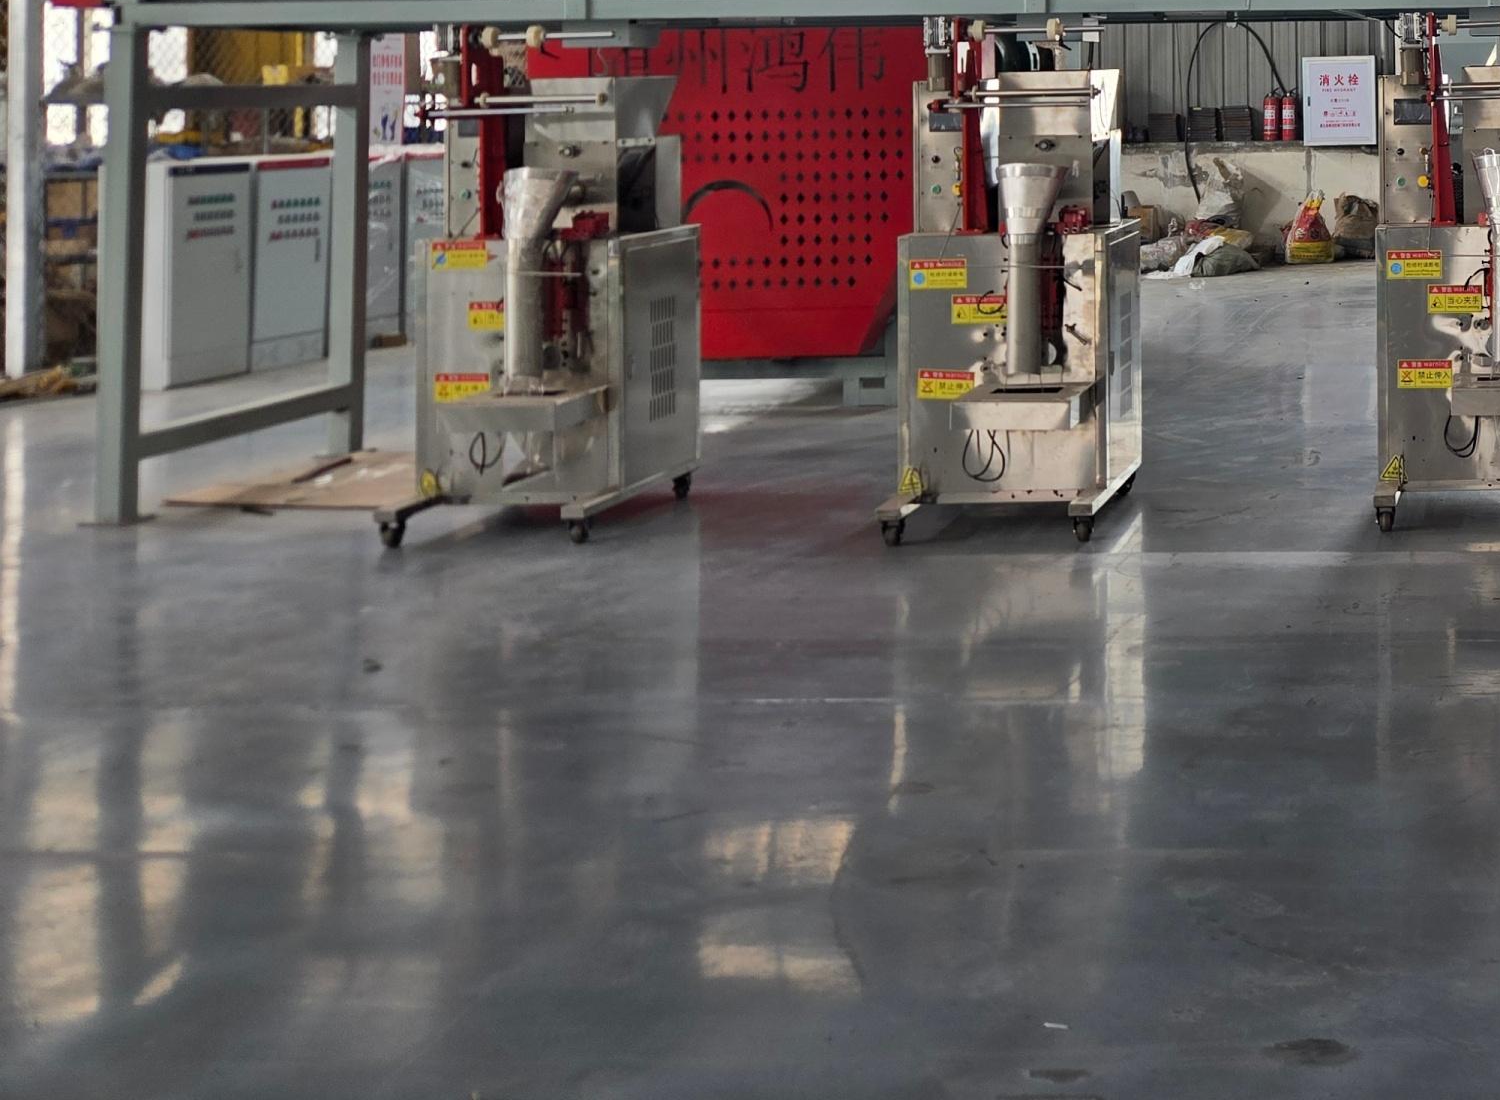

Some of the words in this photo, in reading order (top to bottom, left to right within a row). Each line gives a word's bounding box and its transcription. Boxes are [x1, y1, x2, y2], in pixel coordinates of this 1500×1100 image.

[1319, 73, 1359, 87] 消火栓
[1423, 361, 1449, 369] warning
